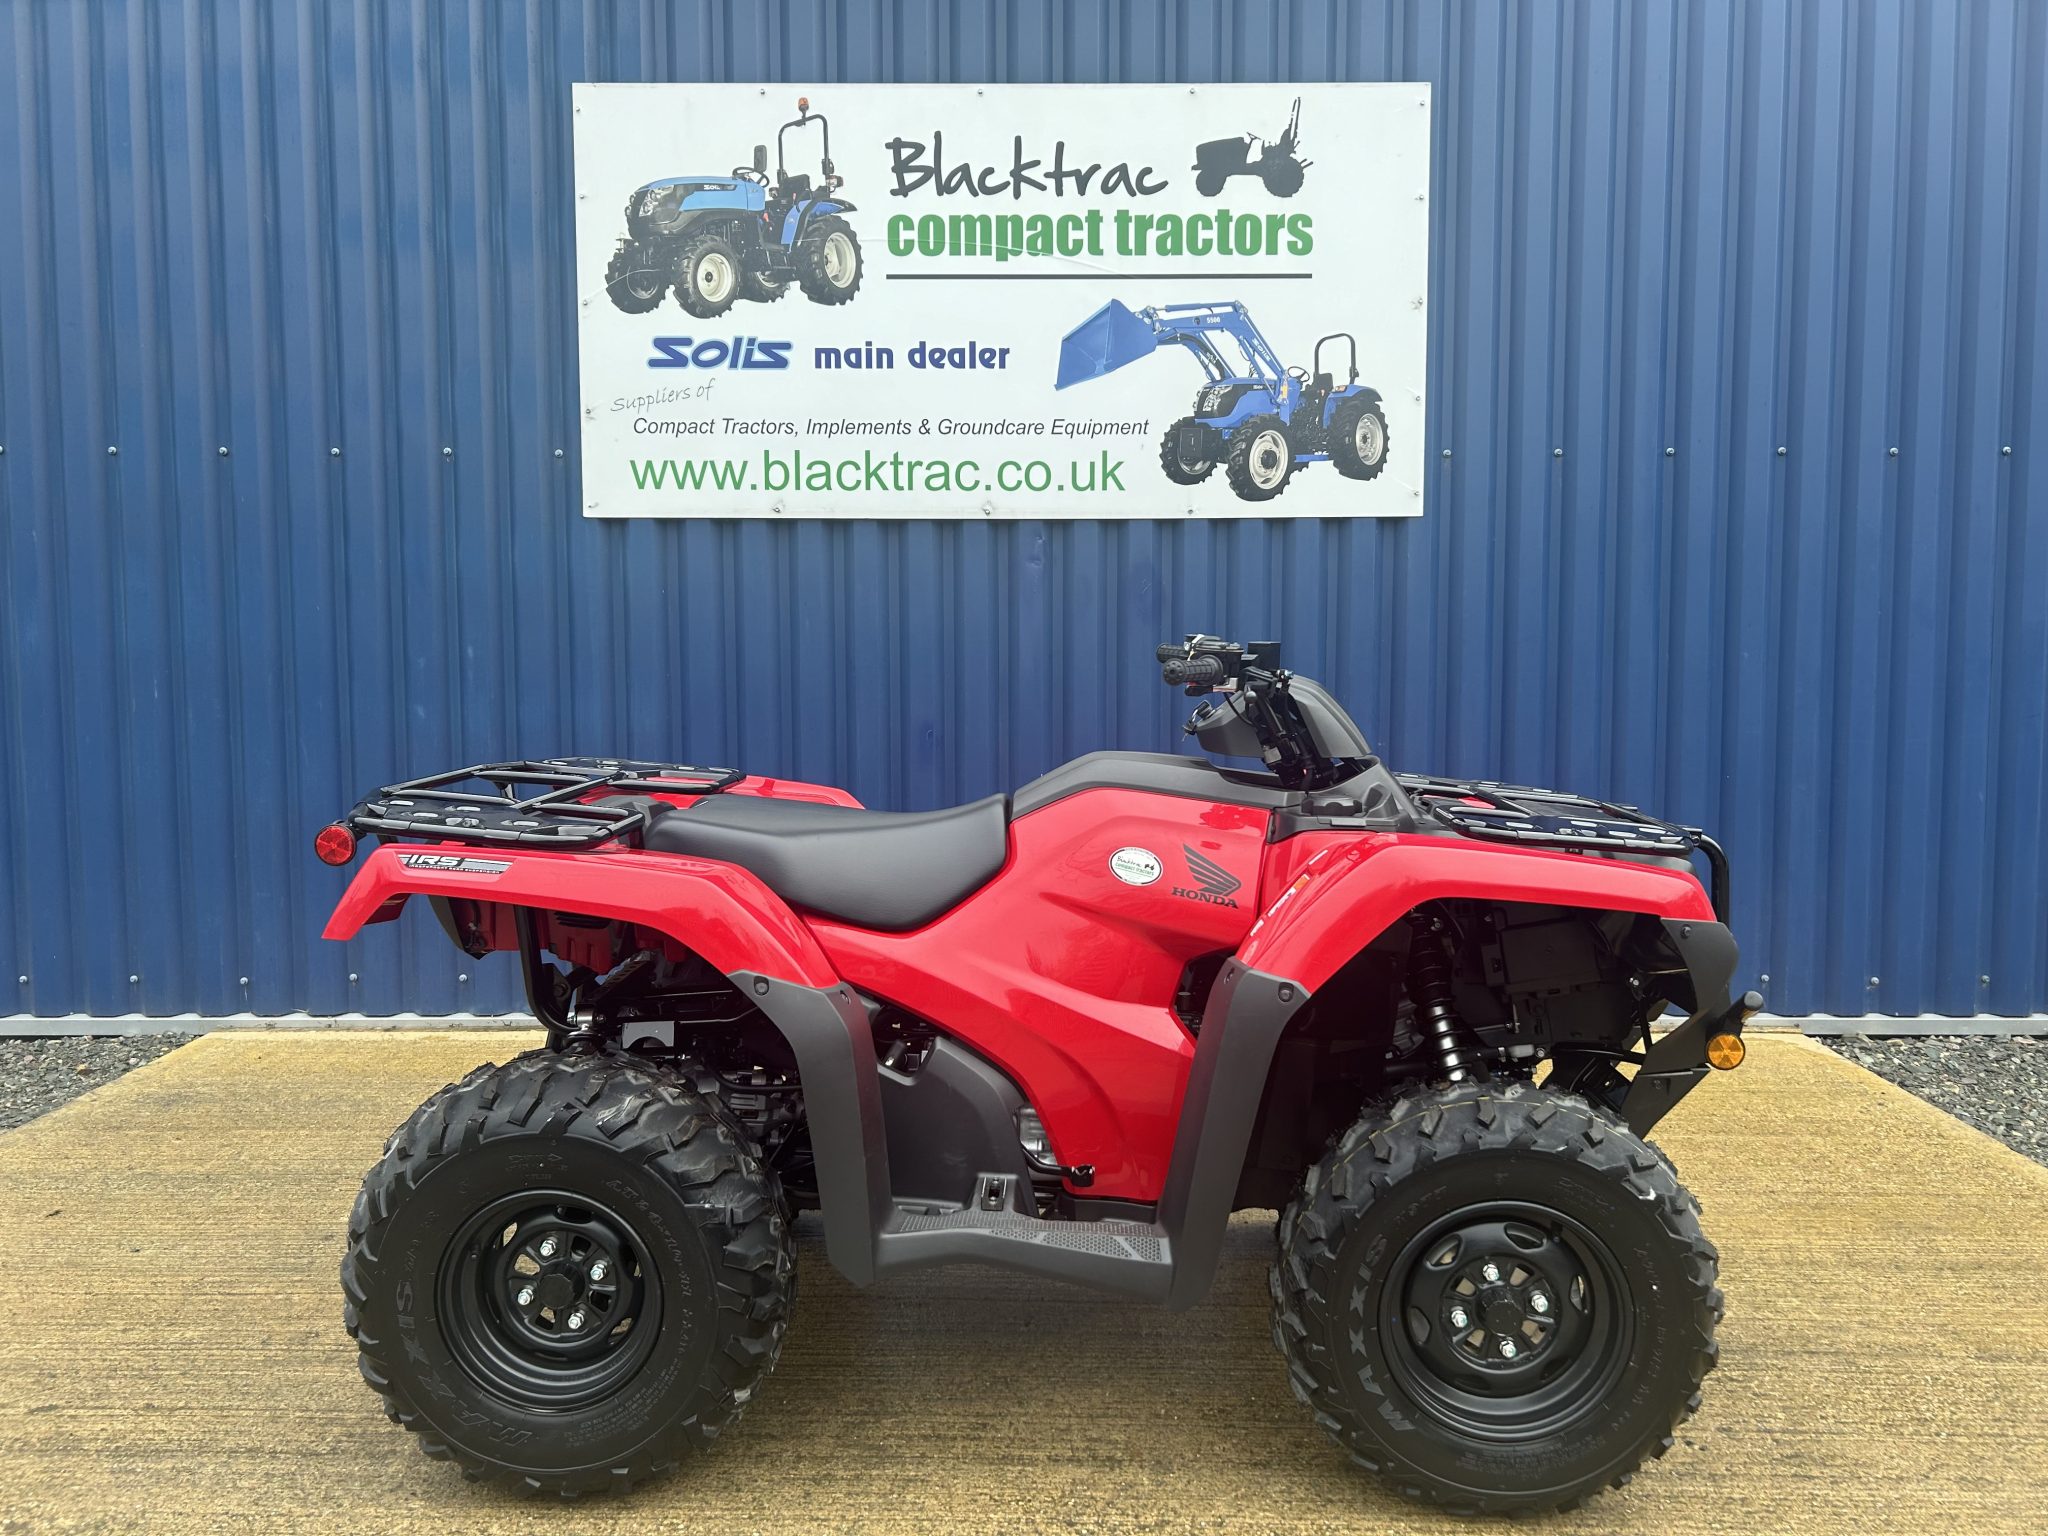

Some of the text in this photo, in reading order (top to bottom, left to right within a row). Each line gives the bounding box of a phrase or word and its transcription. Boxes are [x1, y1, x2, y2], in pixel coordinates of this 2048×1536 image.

[885, 131, 1168, 200] Blacktrac
[887, 209, 1313, 262] compact tractors
[814, 341, 894, 369] main
[908, 341, 1010, 369] dealer
[610, 377, 716, 413] Suppliers of
[633, 417, 1150, 440] Compact Tractors, Implements & Groundcare Equipment
[629, 449, 1126, 492] www.blacktrac.co.uk
[409, 854, 460, 865] IRS
[1172, 887, 1238, 909] HONDA
